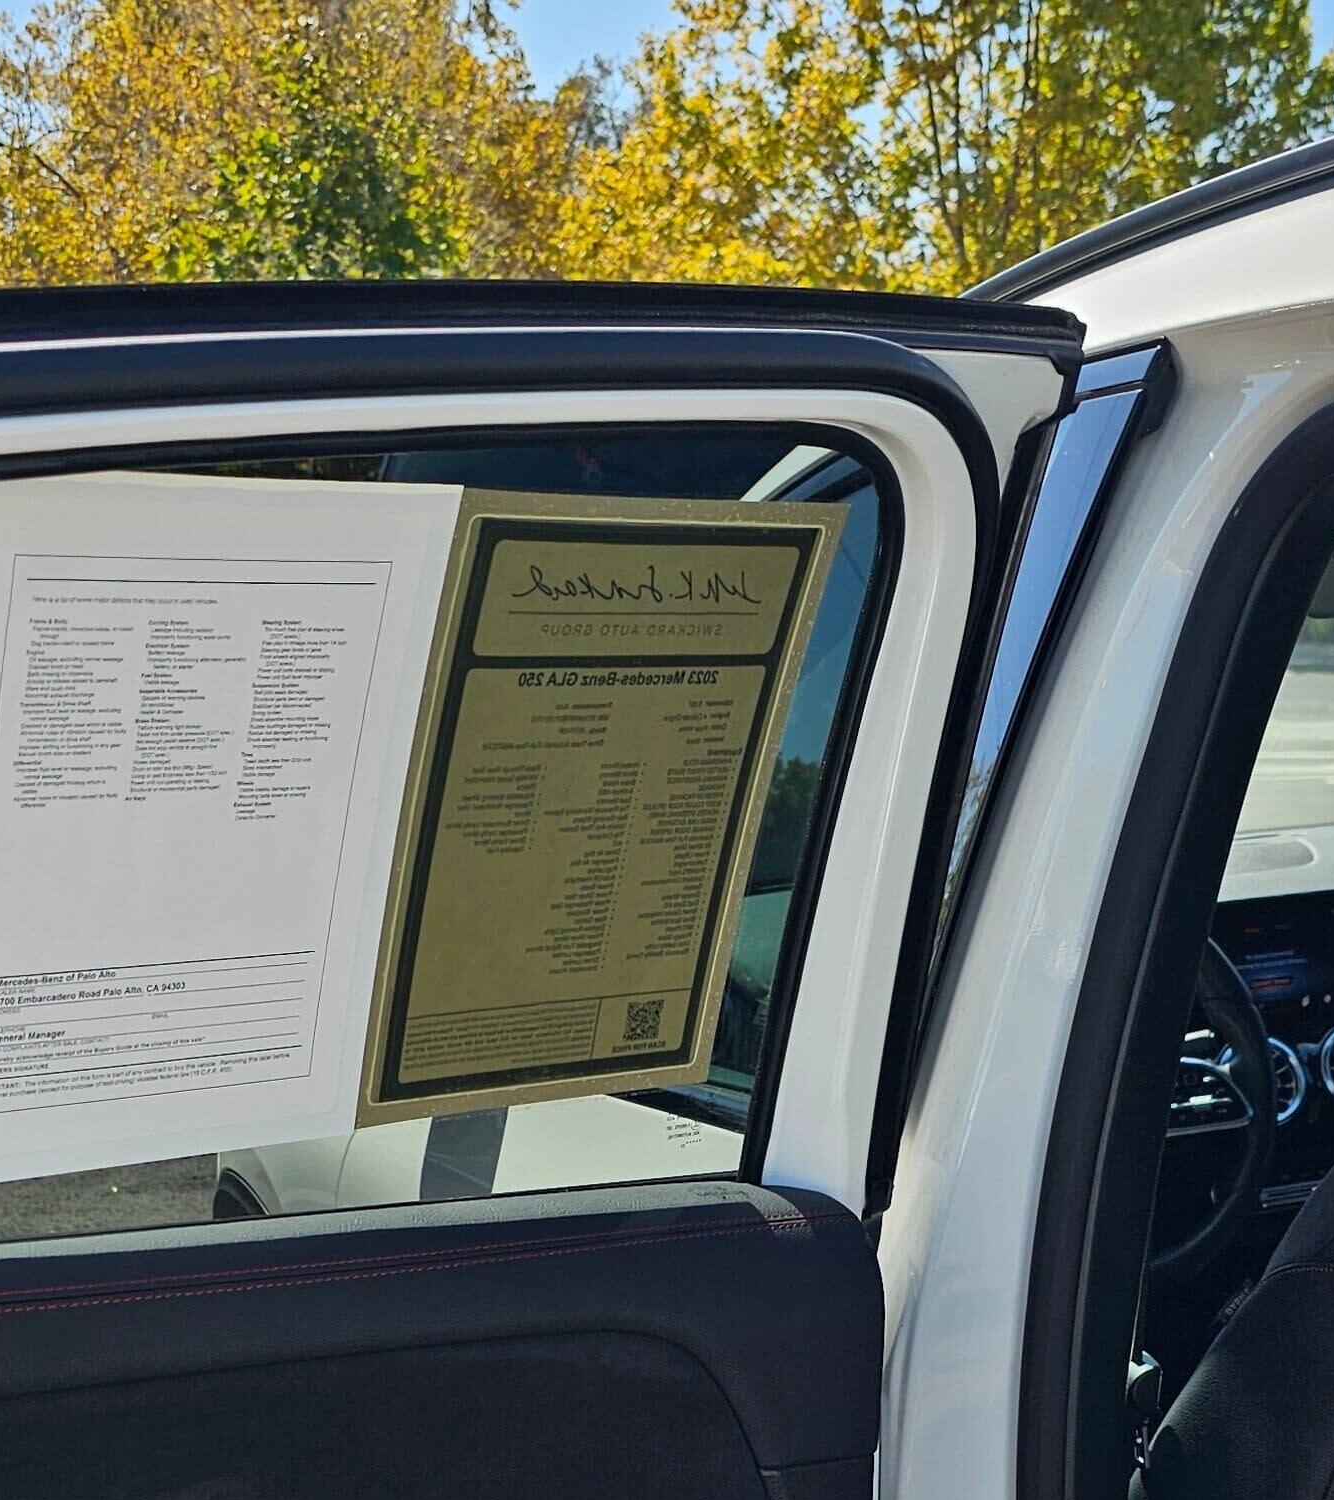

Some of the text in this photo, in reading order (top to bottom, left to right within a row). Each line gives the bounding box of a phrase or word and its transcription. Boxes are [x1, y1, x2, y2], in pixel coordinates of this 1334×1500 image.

[66, 974, 75, 982] of
[98, 971, 116, 979] Alto
[17, 994, 77, 1004] Embarcadero
[79, 990, 101, 998] Road
[103, 988, 123, 996] Palo
[146, 984, 159, 992] CA
[28, 1030, 65, 1040] Manager
